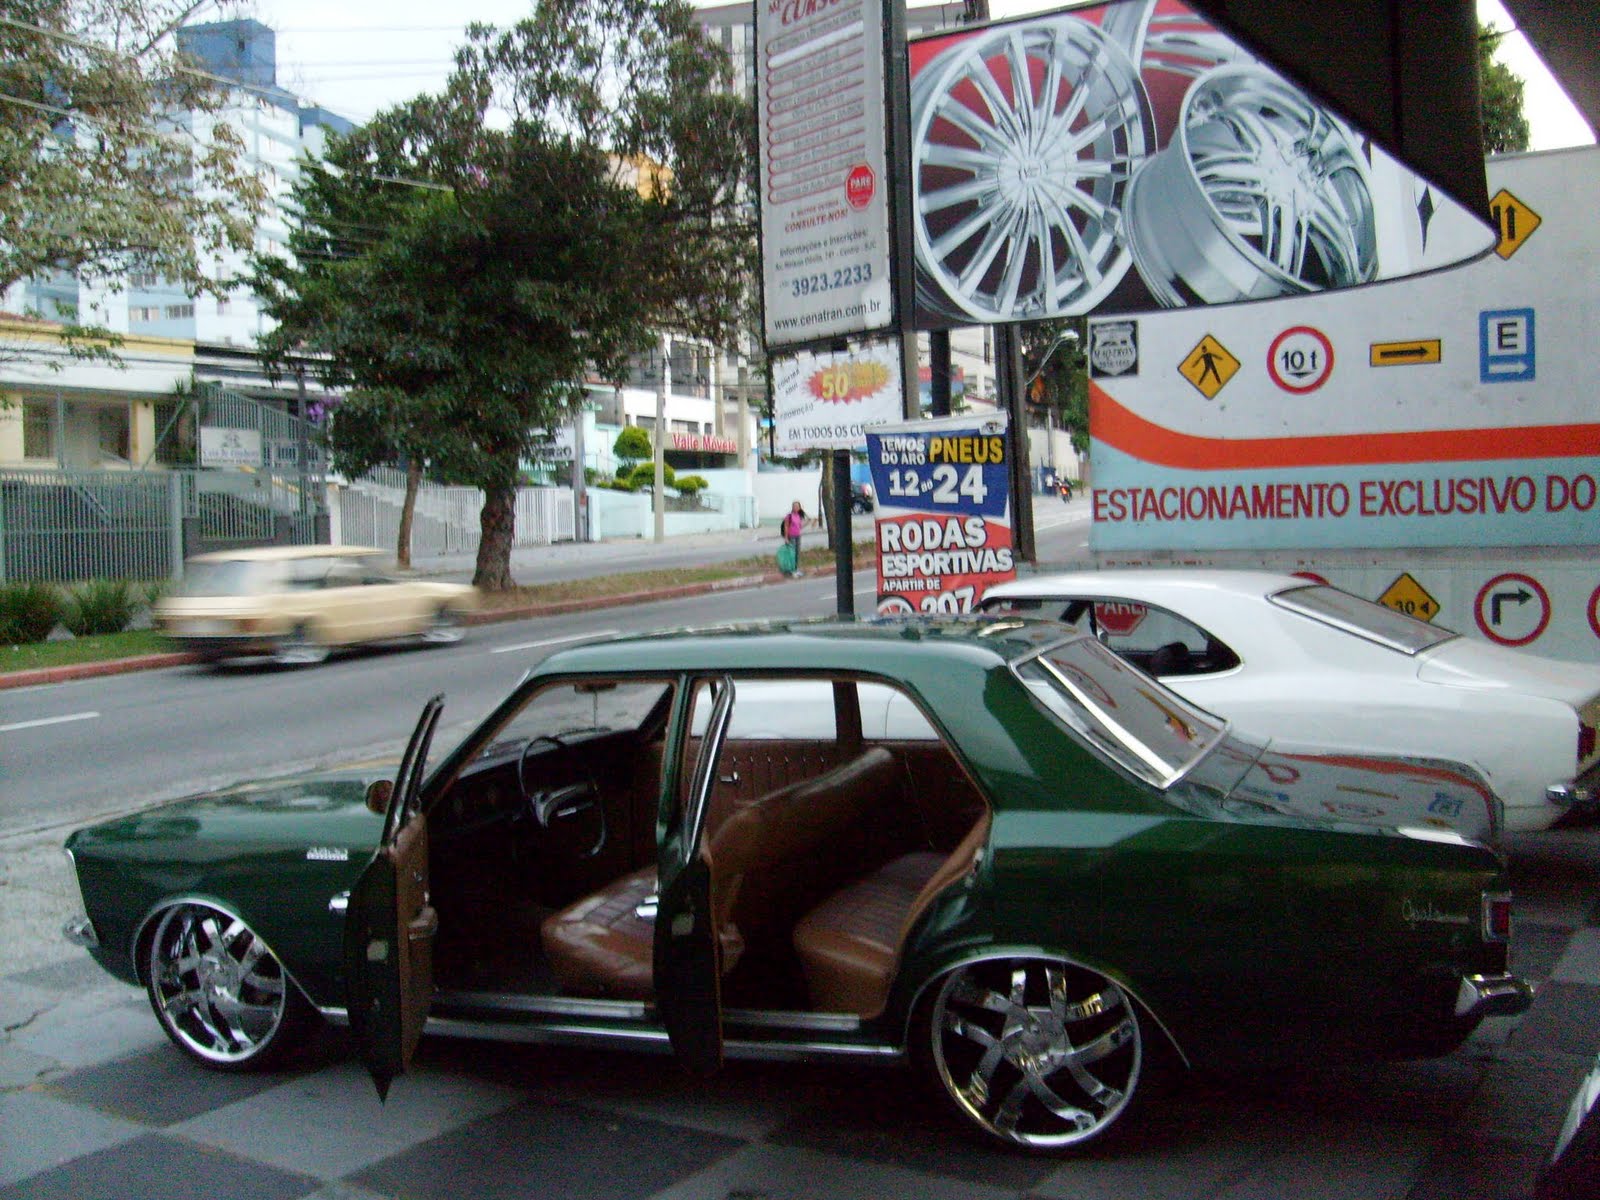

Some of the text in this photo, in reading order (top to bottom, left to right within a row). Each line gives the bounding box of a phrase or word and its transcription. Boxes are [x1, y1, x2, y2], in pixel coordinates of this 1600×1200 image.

[791, 263, 872, 298] 3923.2233
[774, 298, 881, 330] www.cenatran.com.br
[1497, 322, 1518, 350] E
[822, 372, 849, 399] 50
[672, 433, 699, 450] Valle
[788, 427, 801, 440] EM
[803, 425, 833, 440] TODOS
[835, 425, 848, 438] OS
[880, 436, 1003, 465] TEMOS PNEUS
[881, 451, 926, 466] DO ARO
[889, 469, 920, 496] 12
[932, 464, 988, 504] 24
[1093, 474, 1597, 523] ESTACIONAMENTO EXCLUSIVO DO
[880, 515, 988, 553] RODAS
[880, 549, 1013, 578] ESPORTIVAS
[883, 578, 941, 592] APARTIR DE
